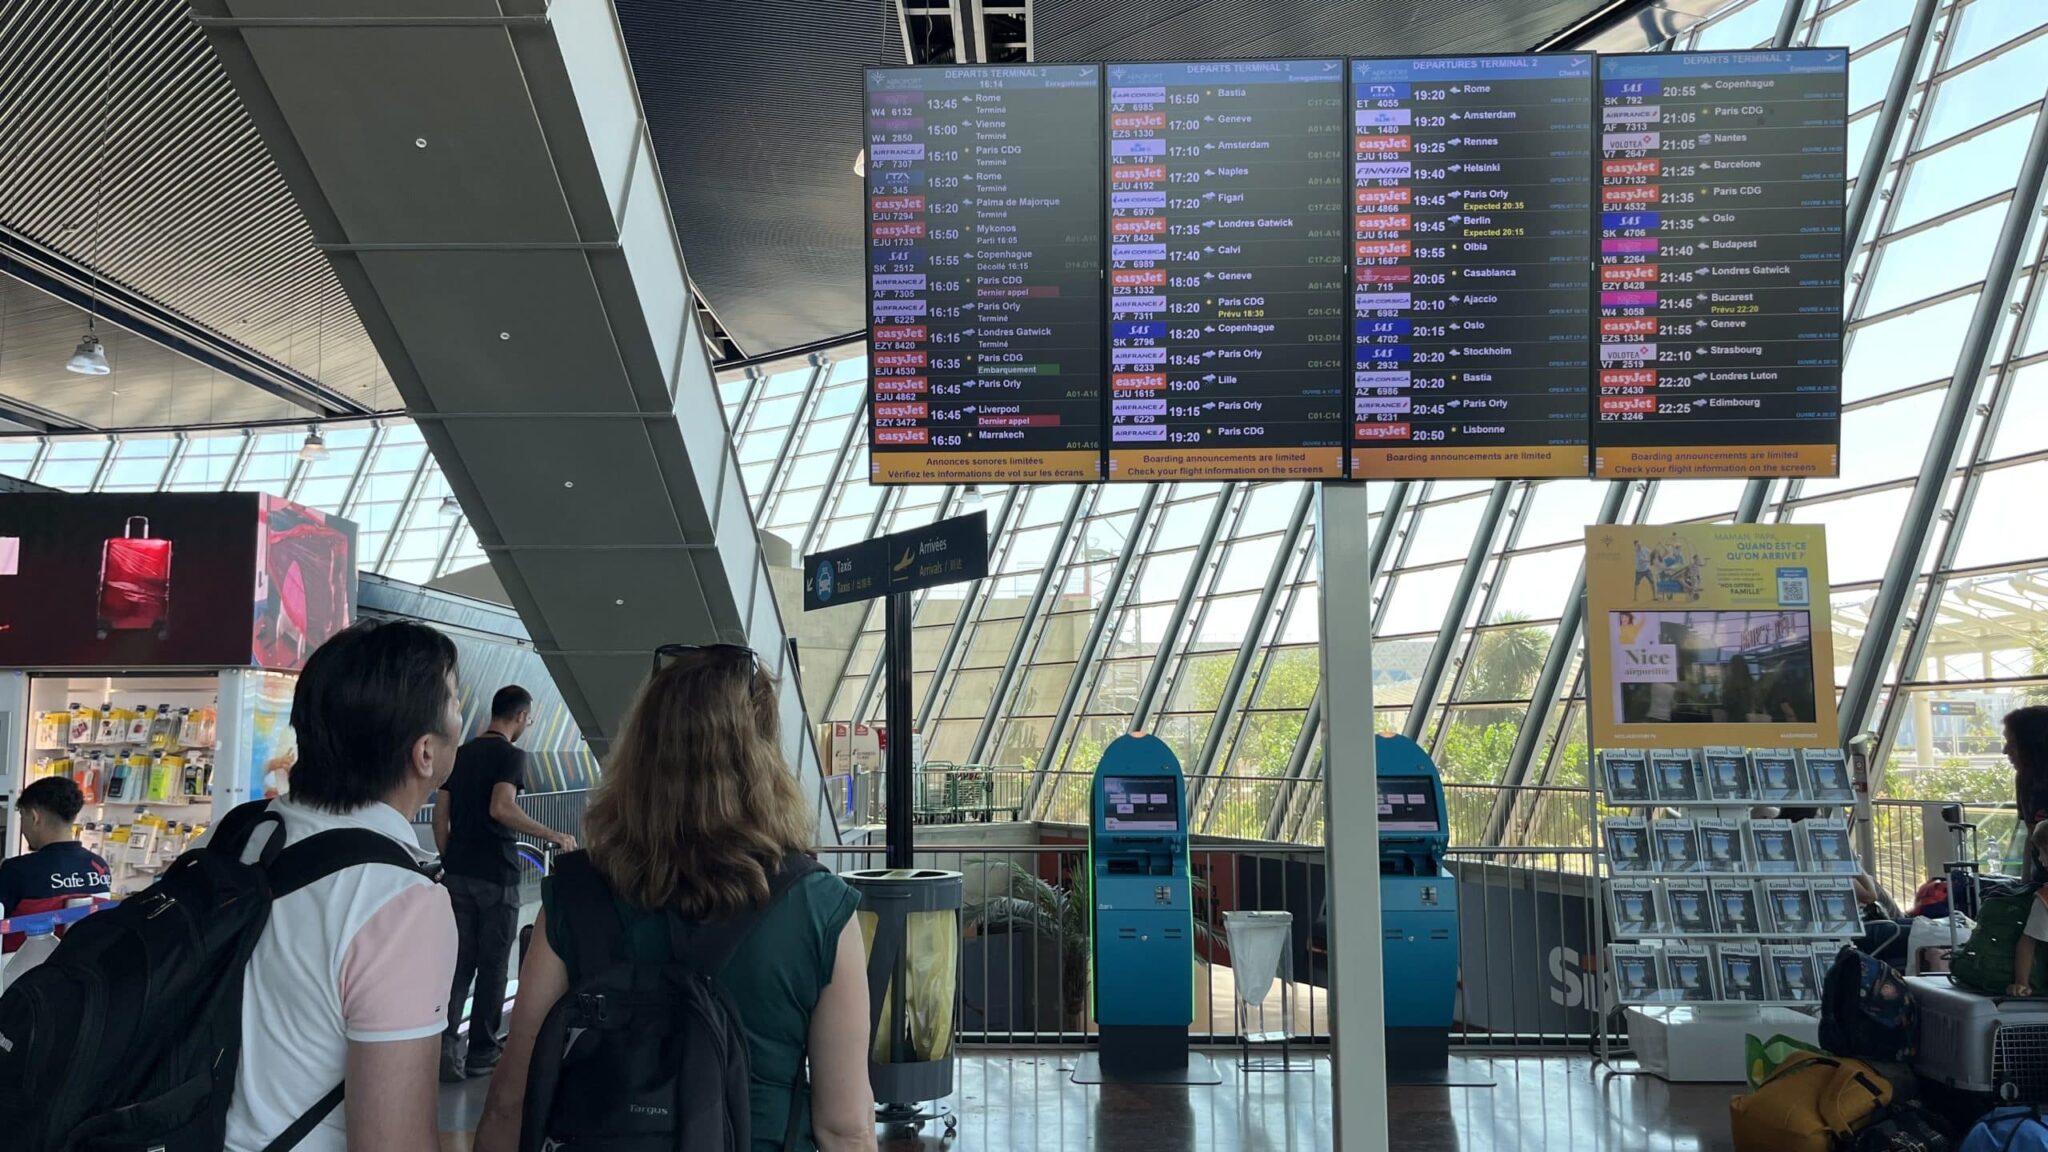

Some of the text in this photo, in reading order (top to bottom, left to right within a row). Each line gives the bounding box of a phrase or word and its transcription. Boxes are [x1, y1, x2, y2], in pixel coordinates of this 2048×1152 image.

[1413, 59, 1538, 70] DEPARTURES TERMINAL 2
[945, 69, 1047, 78] DEPARTS TERMINAL 2
[1463, 85, 1491, 93] Rome
[1715, 79, 1775, 90] Copenhague
[1218, 89, 1246, 97] Bastia
[1414, 91, 1445, 100] 19:20
[1663, 86, 1696, 97] 20:55
[976, 94, 1001, 102] Rome
[1169, 94, 1200, 104] 16:50
[927, 100, 957, 109] 13:45
[1463, 111, 1516, 119] Amsterdam
[1715, 106, 1763, 115] Paris CDG
[1218, 115, 1252, 123] Geneve
[976, 120, 1006, 128] Vienne
[1463, 138, 1498, 146] Rennes
[1714, 134, 1747, 142] Nantes
[1218, 141, 1269, 149] Amsterdam
[1414, 143, 1445, 153] 19:25
[1662, 140, 1695, 150] 21:05
[976, 146, 1021, 154] Paris CDG
[1169, 147, 1200, 156] 17:10
[927, 151, 958, 161] 15:10
[1463, 164, 1500, 172] Helsinki
[1713, 160, 1761, 168] Barcelone
[1218, 167, 1249, 177] Naples
[1357, 167, 1410, 176] FINNAIR
[1489, 190, 1509, 200] Orly
[1713, 186, 1762, 195] Paris CDG
[1218, 193, 1244, 203] Figari
[1414, 196, 1445, 206] 19:45
[1662, 193, 1694, 203] 21:35
[1019, 198, 1060, 208] Majorque
[1169, 199, 1200, 209] 17:20
[1464, 202, 1524, 212] Expected 20:35
[928, 204, 958, 213] 15:20
[1463, 217, 1491, 225] Berlin
[1713, 214, 1735, 222] Oslo
[1218, 219, 1293, 228] Londres Gatwick
[976, 225, 1016, 234] Mykonos
[1463, 243, 1488, 251] Olbia
[1713, 240, 1757, 250] Budapest
[1218, 246, 1241, 254] Calvi
[1414, 248, 1445, 258] 19:55
[1661, 246, 1693, 256] 21:40
[977, 250, 1032, 260] Copenhague
[1169, 251, 1200, 261] 17:40
[929, 256, 959, 266] 15:55
[1463, 269, 1516, 277] Casablanca
[1712, 266, 1790, 275] Londres Gatwick
[977, 276, 1023, 285] Paris CDG
[1218, 272, 1252, 280] Geneve
[1463, 295, 1497, 305] Ajaccio
[1711, 293, 1753, 301] Bucarest
[1218, 298, 1264, 306] Paris CDG
[1413, 301, 1445, 310] 20:10
[1660, 299, 1693, 309] 21:45
[977, 303, 1021, 312] Paris Orly
[1169, 303, 1200, 313] 18:20
[929, 308, 960, 317] 16:15
[1463, 321, 1485, 329] Oslo
[1711, 319, 1746, 328] Geneve
[978, 328, 1052, 336] Londres Gatwick
[1218, 324, 1275, 333] Copenhague
[1218, 350, 1263, 360] Paris Orly
[1463, 347, 1512, 355] Stockholm
[1607, 351, 1640, 359] VOLOTEA
[1710, 346, 1762, 355] Strasbourg
[978, 354, 1001, 362] Paris
[1169, 355, 1200, 365] 18:45
[1413, 353, 1445, 363] 20:20
[1659, 351, 1692, 361] 22:10
[930, 359, 960, 369] 16:35
[1218, 376, 1237, 384] Lille
[1463, 373, 1492, 381] Bastia
[1710, 372, 1777, 380] Londres Luton
[978, 380, 1021, 389] Paris Orly
[1218, 401, 1262, 411] Paris Orly
[1463, 399, 1508, 409] Paris Orly
[1709, 398, 1760, 407] Edimbourg
[978, 405, 1020, 415] Liverpool
[1169, 407, 1200, 417] 19:15
[1413, 405, 1445, 415] 20:45
[1658, 404, 1691, 414] 22:25
[931, 410, 961, 420] 16:45
[1243, 427, 1264, 435] CDG
[1358, 426, 1407, 436] easyJet
[1463, 425, 1505, 434] Lisbonne
[979, 431, 1024, 439] Marrakech
[931, 436, 961, 446] 16:50
[1143, 455, 1184, 463] Boarding
[1275, 453, 1306, 461] limited
[1128, 468, 1155, 476] Check
[1157, 469, 1178, 477] your
[1205, 466, 1256, 474] information
[1272, 466, 1286, 474] the
[919, 537, 947, 555] Arrivées
[1737, 542, 1807, 550] QUAND EST-CE
[1761, 552, 1797, 560] ARRIVE
[837, 558, 852, 574] Taxis
[920, 560, 943, 576] Arrivals
[1625, 649, 1670, 665] Nice
[51, 871, 112, 888] Safe Bag
[629, 1104, 668, 1115] Targus
